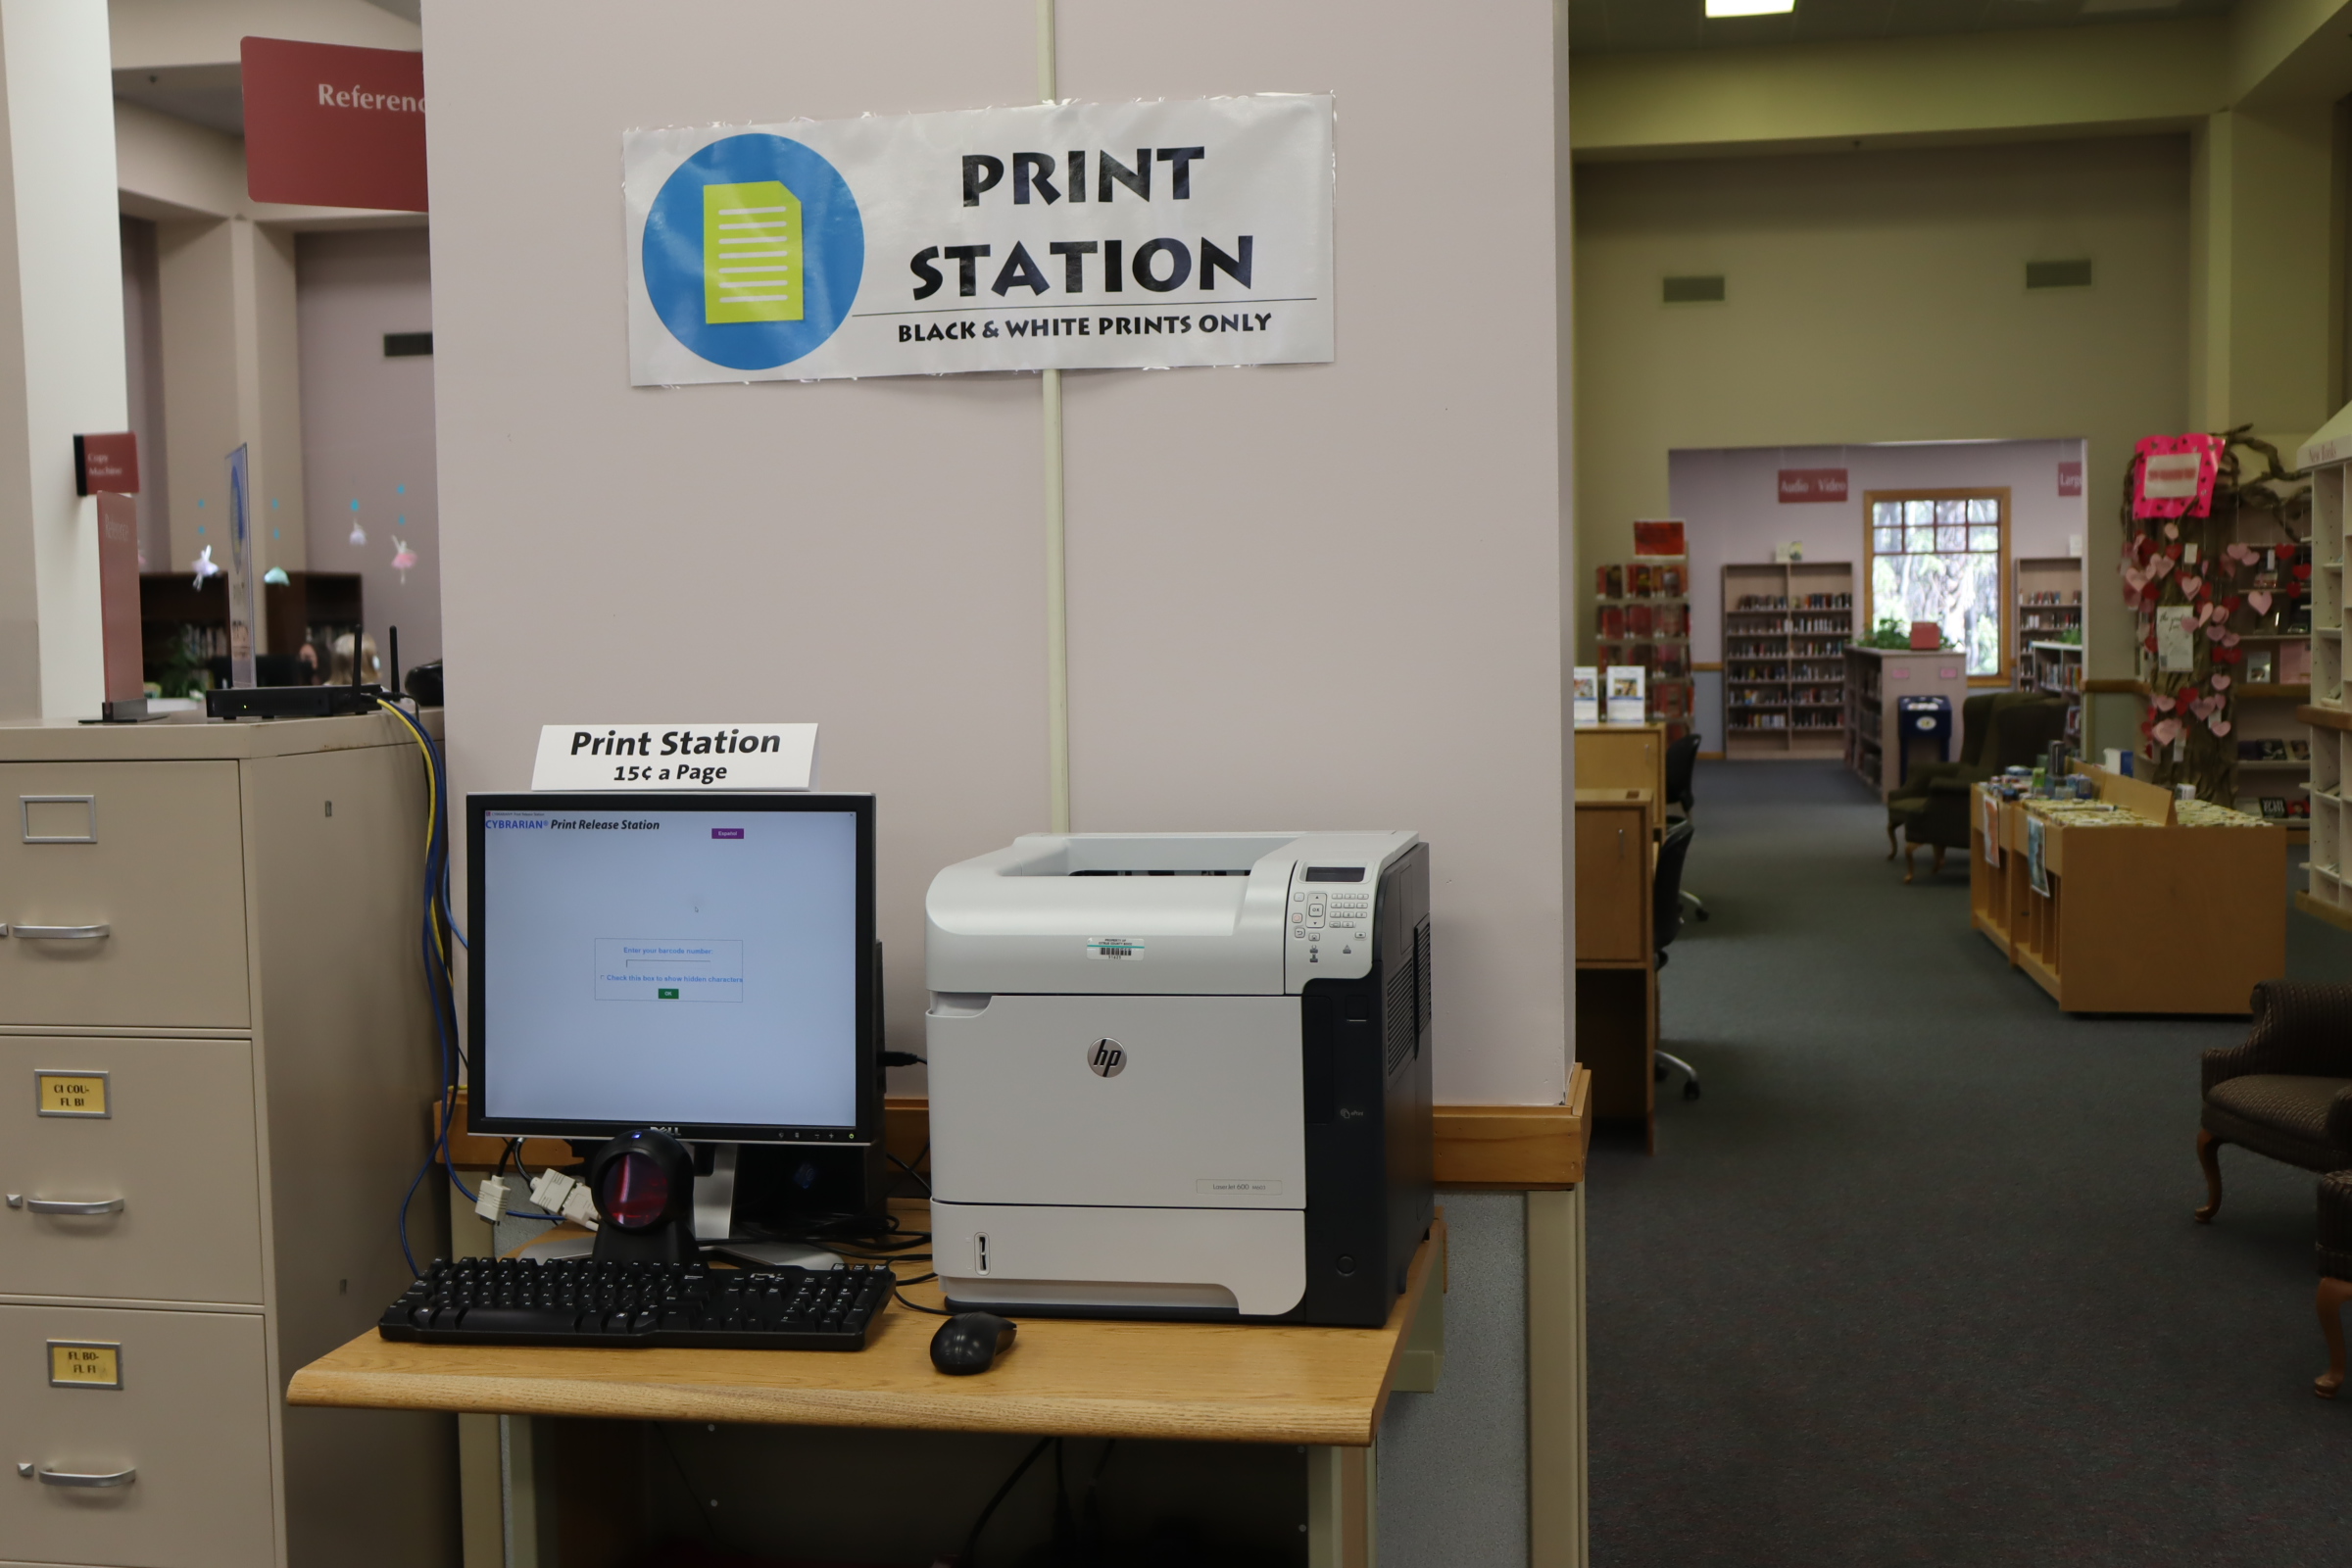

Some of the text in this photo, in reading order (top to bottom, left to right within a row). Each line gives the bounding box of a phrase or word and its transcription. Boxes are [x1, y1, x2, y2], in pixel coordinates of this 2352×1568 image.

[961, 146, 1205, 208] PRINT
[908, 235, 1254, 301] STATION
[898, 312, 1273, 343] BLACK & WHITE PRINTS ONLY
[571, 728, 781, 756] Print Station
[613, 764, 727, 785] 15¢ a Page
[551, 819, 577, 830] Print
[578, 819, 619, 830] Release
[621, 819, 660, 830] Station
[1092, 1039, 1122, 1077] hp
[60, 1097, 84, 1106] FL BI
[68, 1351, 79, 1360] FL
[74, 1364, 96, 1373] FL FI
